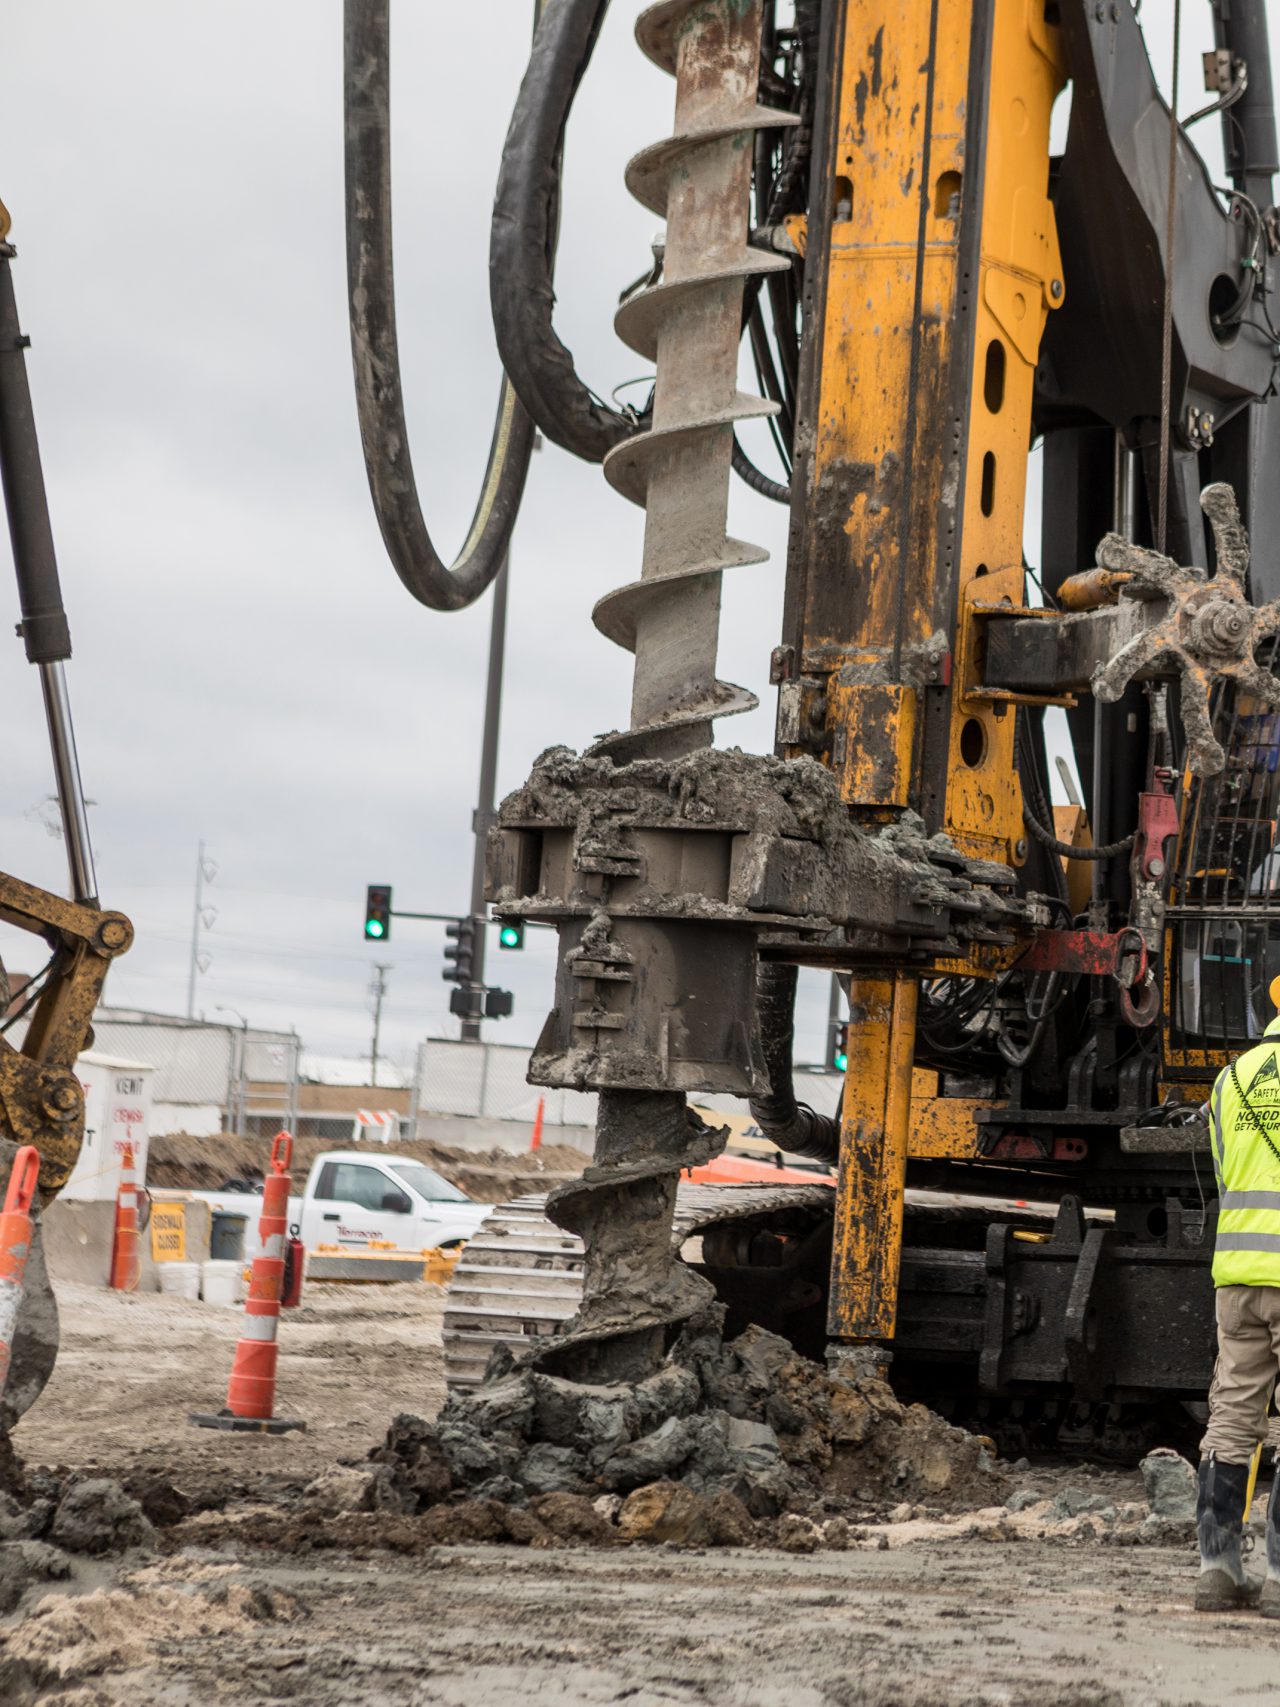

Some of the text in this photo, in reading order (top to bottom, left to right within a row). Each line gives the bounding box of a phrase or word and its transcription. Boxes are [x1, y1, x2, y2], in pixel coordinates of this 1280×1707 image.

[116, 1077, 144, 1095] KIEWIT
[1253, 1088, 1280, 1098] SAFETY
[1234, 1122, 1259, 1131] GETS
[152, 1215, 183, 1230] SIDEWALK
[337, 1225, 383, 1239] Terracon
[158, 1234, 180, 1249] CLOSED
